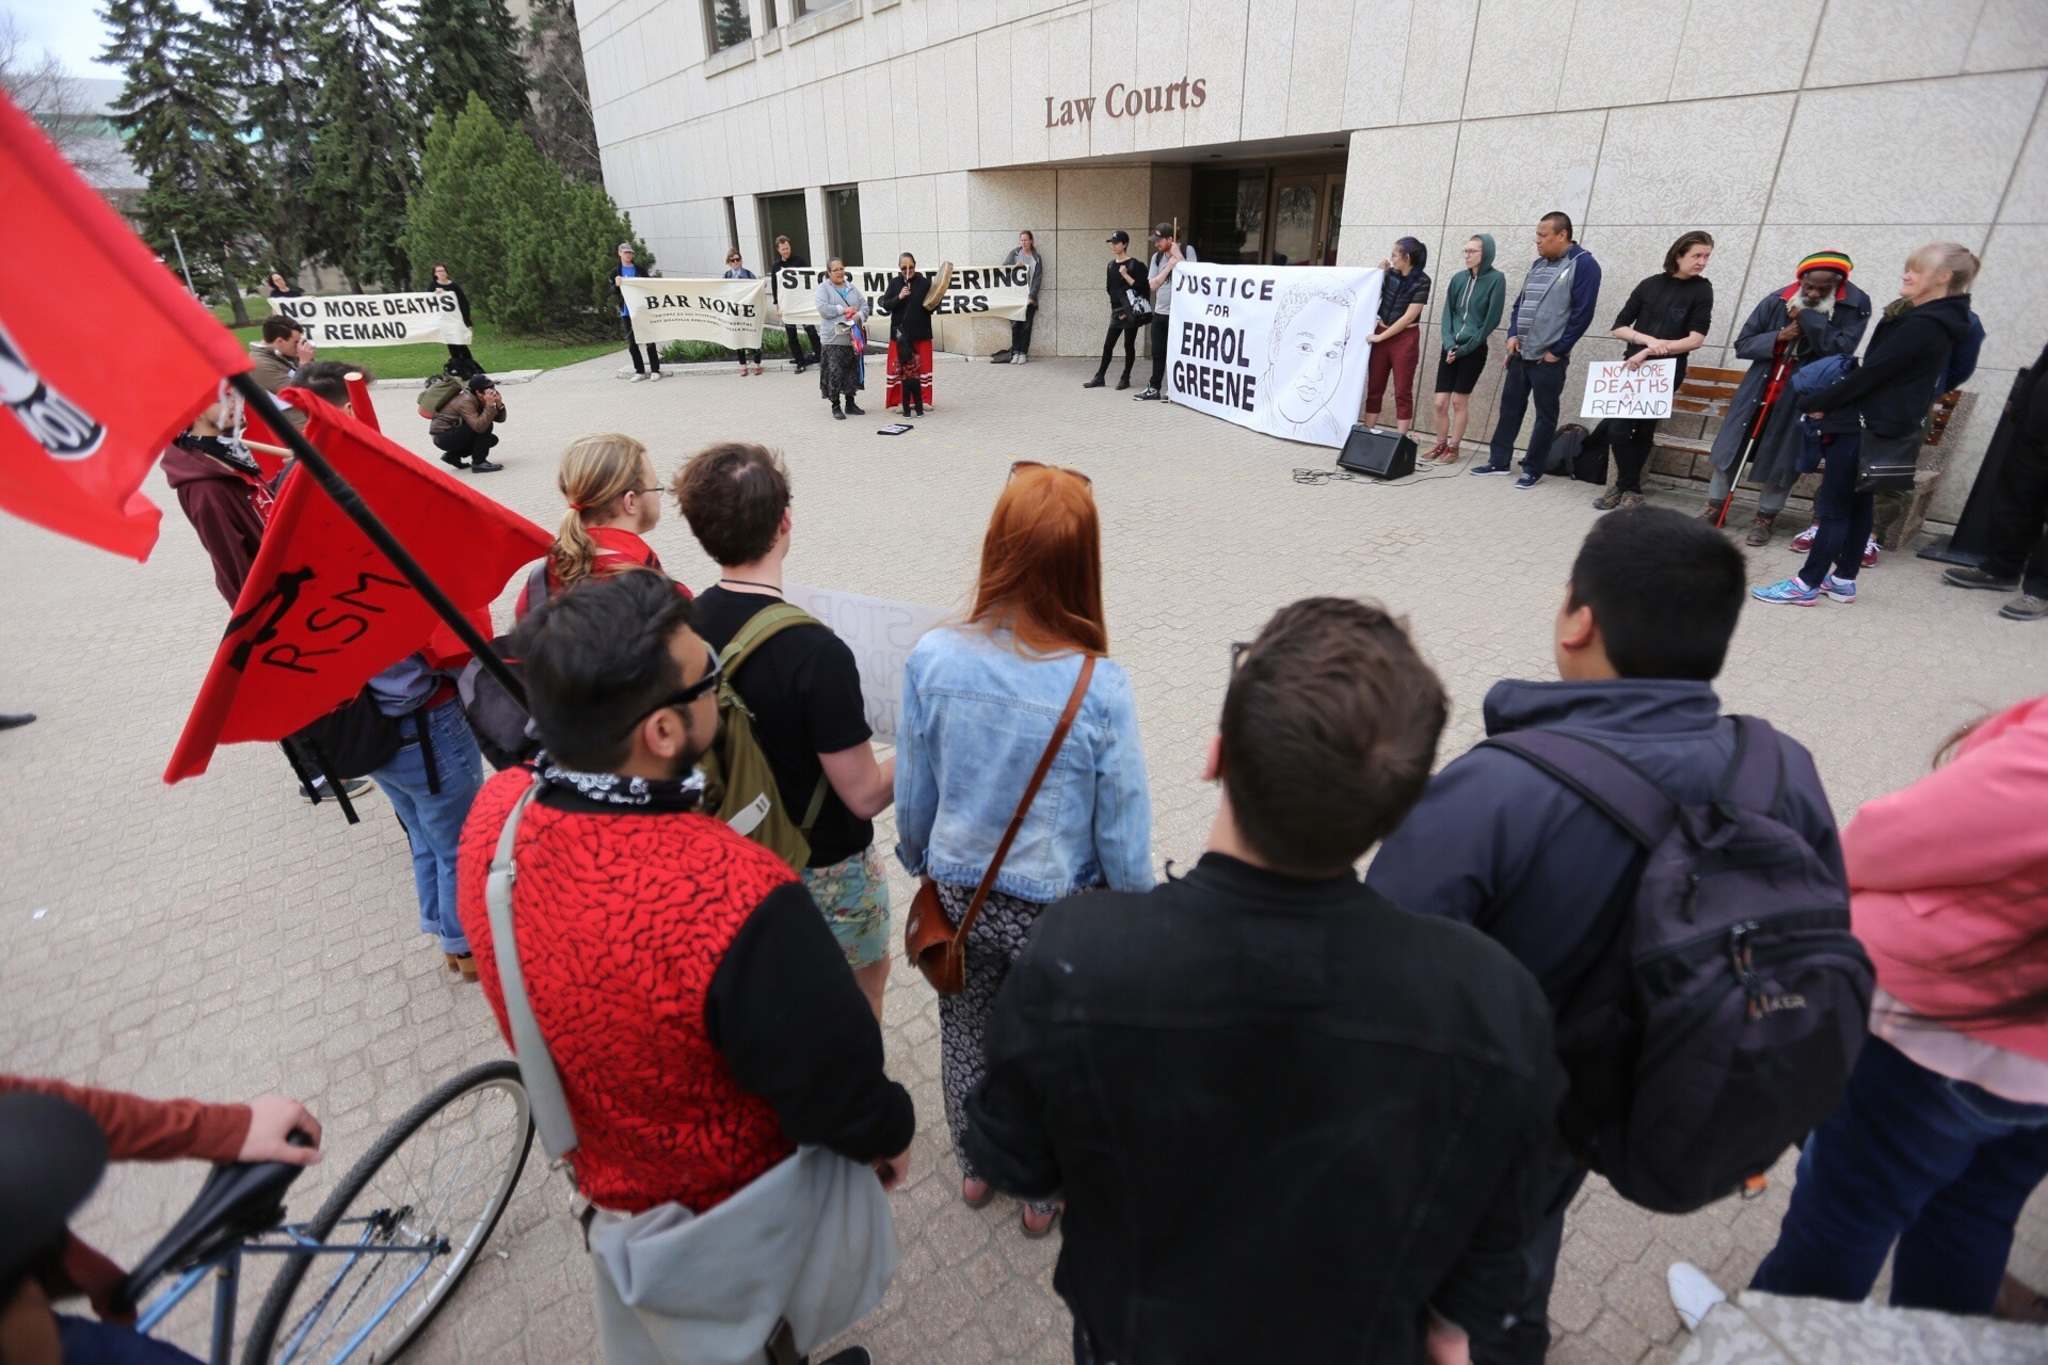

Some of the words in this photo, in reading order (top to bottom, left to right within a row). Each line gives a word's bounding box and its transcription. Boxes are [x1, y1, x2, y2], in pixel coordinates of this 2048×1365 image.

[1045, 96, 1096, 128] Law
[1105, 77, 1207, 118] Courts
[1176, 274, 1275, 301] JUSTICE
[279, 301, 317, 318] NO
[324, 300, 380, 317] MORE
[384, 295, 456, 316] DEATHS
[645, 294, 691, 309] BAR
[698, 296, 756, 318] NONE
[1205, 303, 1230, 318] FOR
[325, 321, 407, 340] REMAND
[1180, 322, 1250, 368] ERROL
[1602, 366, 1623, 378] NO
[1172, 360, 1257, 413] GREENE
[1593, 378, 1669, 394] DEATHS
[1591, 399, 1668, 416] REMAND
[260, 571, 411, 673] RSM
